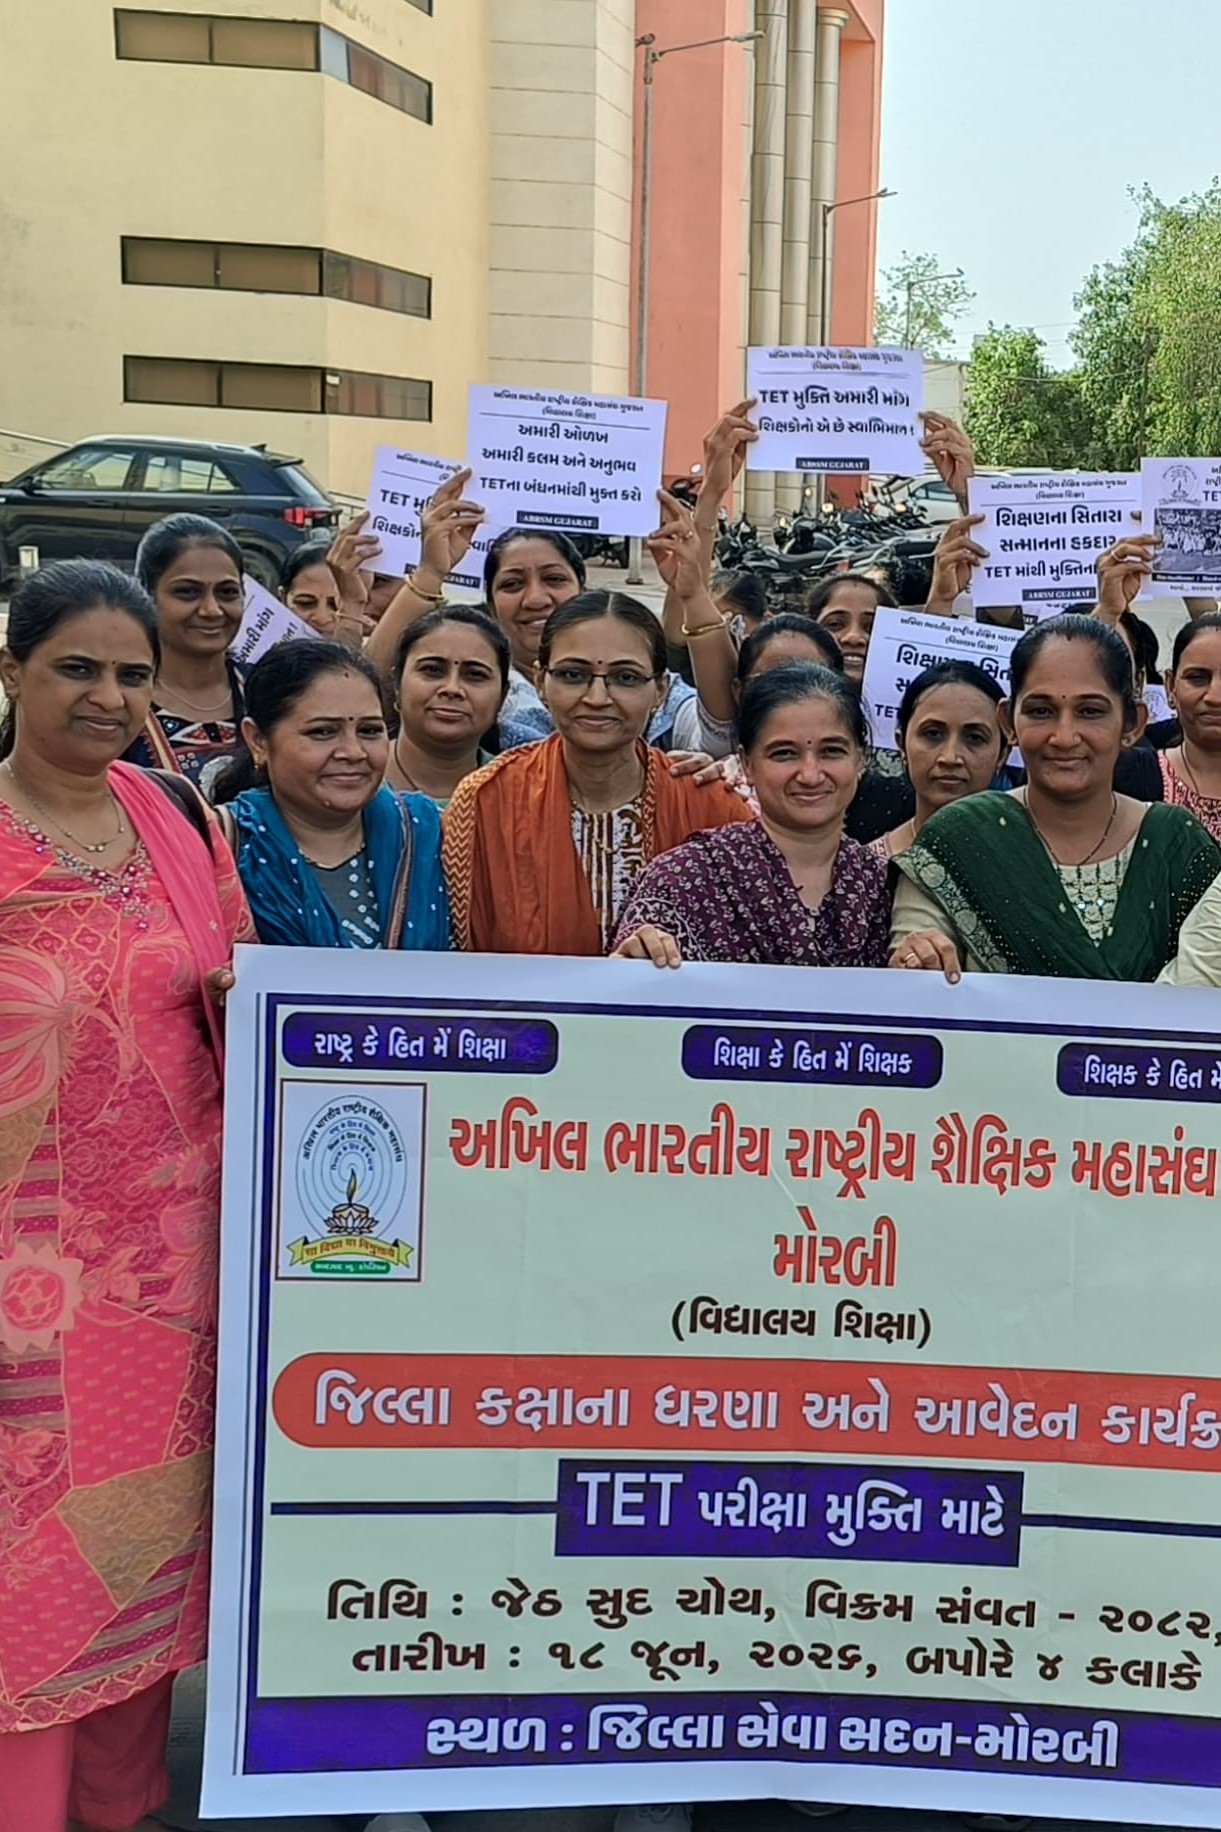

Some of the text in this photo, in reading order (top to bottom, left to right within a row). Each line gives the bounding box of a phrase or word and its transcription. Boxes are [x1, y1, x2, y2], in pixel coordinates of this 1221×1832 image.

[758, 390, 789, 404] TET
[793, 384, 830, 410] મુક્તિ
[834, 386, 878, 405] અમારી
[518, 423, 560, 440] અમારી
[816, 417, 830, 433] એ
[833, 417, 845, 433] છે
[482, 446, 524, 463] અમારી
[527, 451, 560, 467] કલમ
[562, 452, 586, 469] અને
[380, 488, 411, 508] TET
[996, 504, 1122, 528] શિક્ષણના સિતારા
[984, 566, 1012, 579] TET
[314, 1025, 506, 1063] રાષ્ટ્ર કે હિત મેં શિક્ષા
[713, 1036, 913, 1077] શિક્ષા કે હિત મેં શિક્ષક
[1084, 1054, 1138, 1088] શિક્ષક
[1145, 1057, 1162, 1086] કે
[1169, 1059, 1203, 1089] હિત
[449, 1096, 588, 1171] અખિલ
[603, 1102, 770, 1176] ભારતીય
[785, 1108, 915, 1199] રાષ્ટ્રીય
[931, 1111, 1056, 1196] શૈક્ષિક
[1071, 1125, 1217, 1197] મહાસંઘ
[773, 1205, 897, 1287] મોરબી
[834, 1299, 931, 1349] શિક્ષા)
[315, 1369, 450, 1426] જિલ્લા
[475, 1386, 630, 1432] કક્ષાના
[654, 1385, 779, 1430] ધરણા
[802, 1378, 890, 1432] અને
[914, 1383, 1078, 1441] આવેદન
[576, 1472, 1005, 1547] TET પરીક્ષા મુક્તિ માટે
[327, 1578, 428, 1620] તિથિ
[491, 1577, 562, 1618] જેઠ
[586, 1587, 653, 1629] સુદ
[676, 1576, 776, 1623] ચોથ,
[805, 1578, 913, 1623] વિક્રમ
[935, 1586, 1036, 1628] સંવત
[352, 1631, 486, 1672] તારીખ
[548, 1642, 605, 1670] ૧૮
[630, 1639, 719, 1682] જૂન,
[749, 1640, 877, 1679] ૨૦૨૬,
[905, 1638, 1014, 1678] બપોરે
[1036, 1652, 1064, 1681] ૪
[1086, 1650, 1202, 1691] કલાકે
[426, 1715, 547, 1755] સ્થળ
[587, 1703, 725, 1752] જિલ્લા
[736, 1701, 826, 1752] સેવા
[839, 1711, 1119, 1768] સદન-મોરબી
